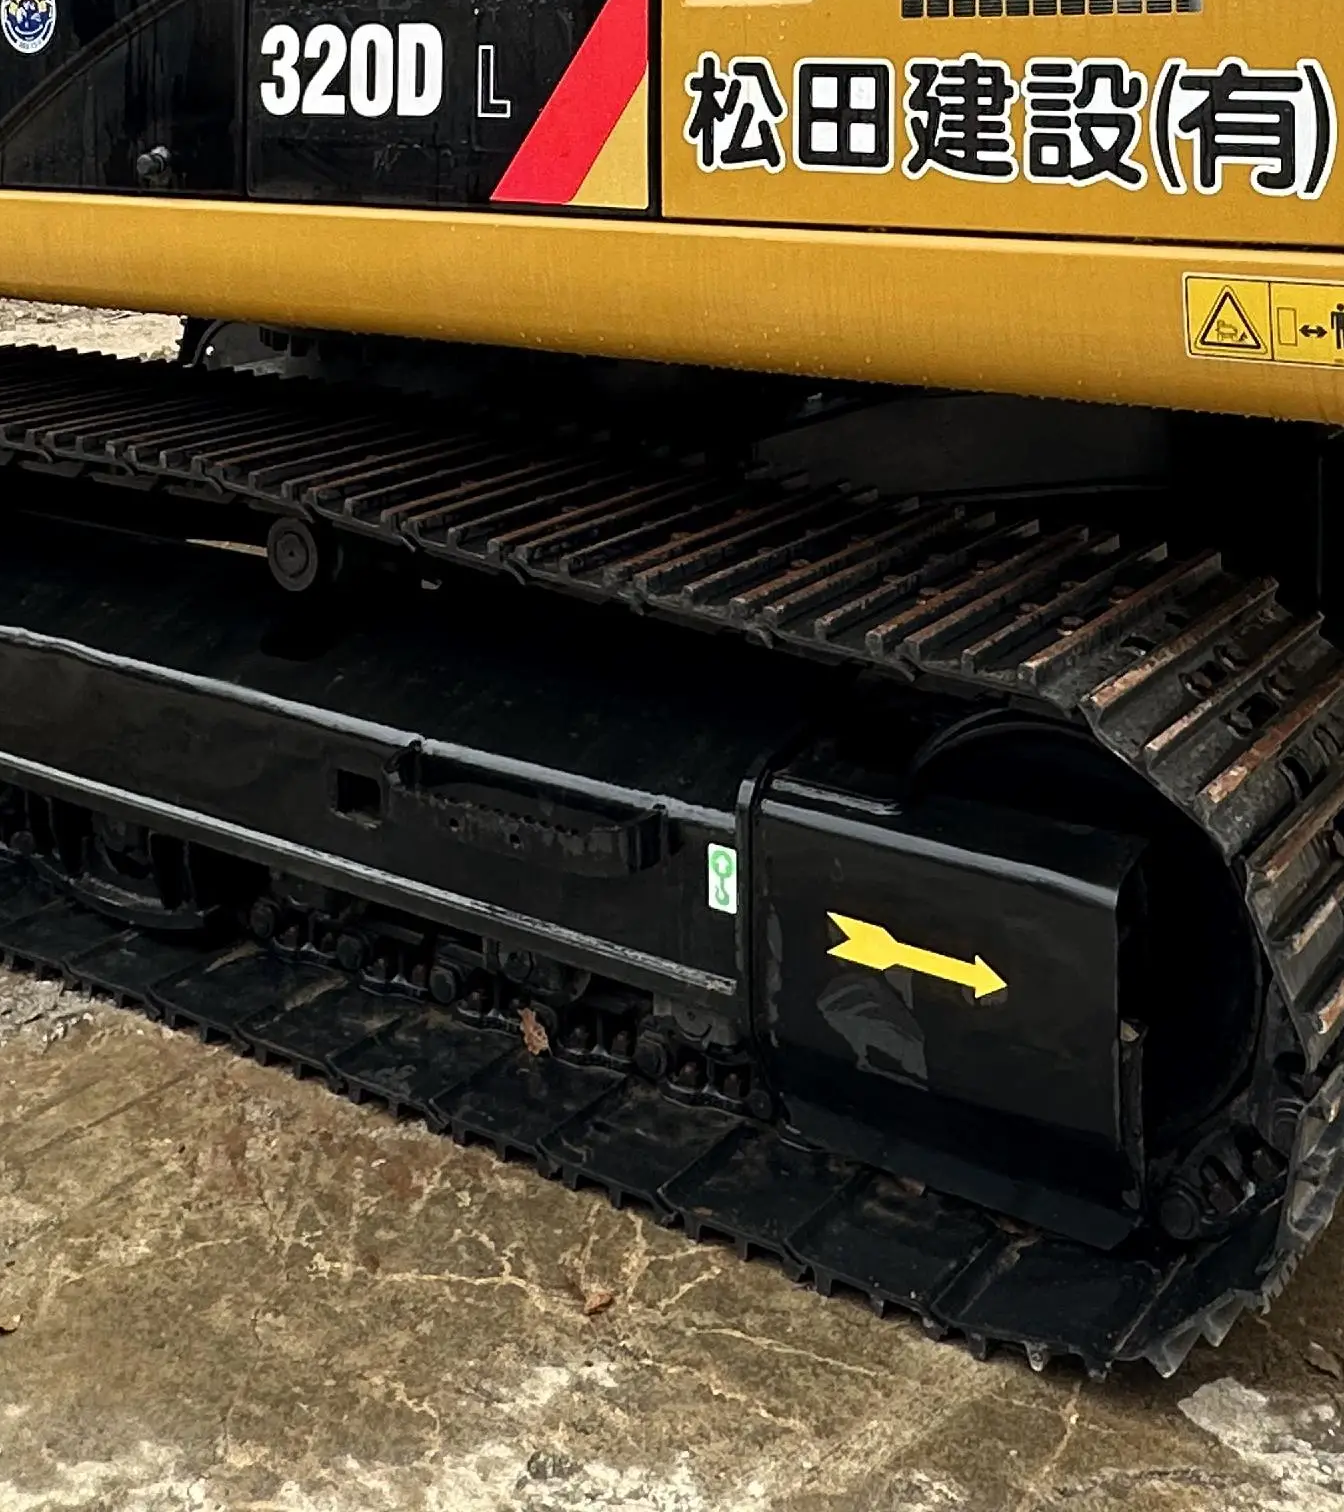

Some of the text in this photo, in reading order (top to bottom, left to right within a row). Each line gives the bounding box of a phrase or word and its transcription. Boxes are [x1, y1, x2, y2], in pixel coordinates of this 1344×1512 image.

[260, 22, 511, 119] 320D L
[684, 52, 1337, 199] 松田建設(有)
